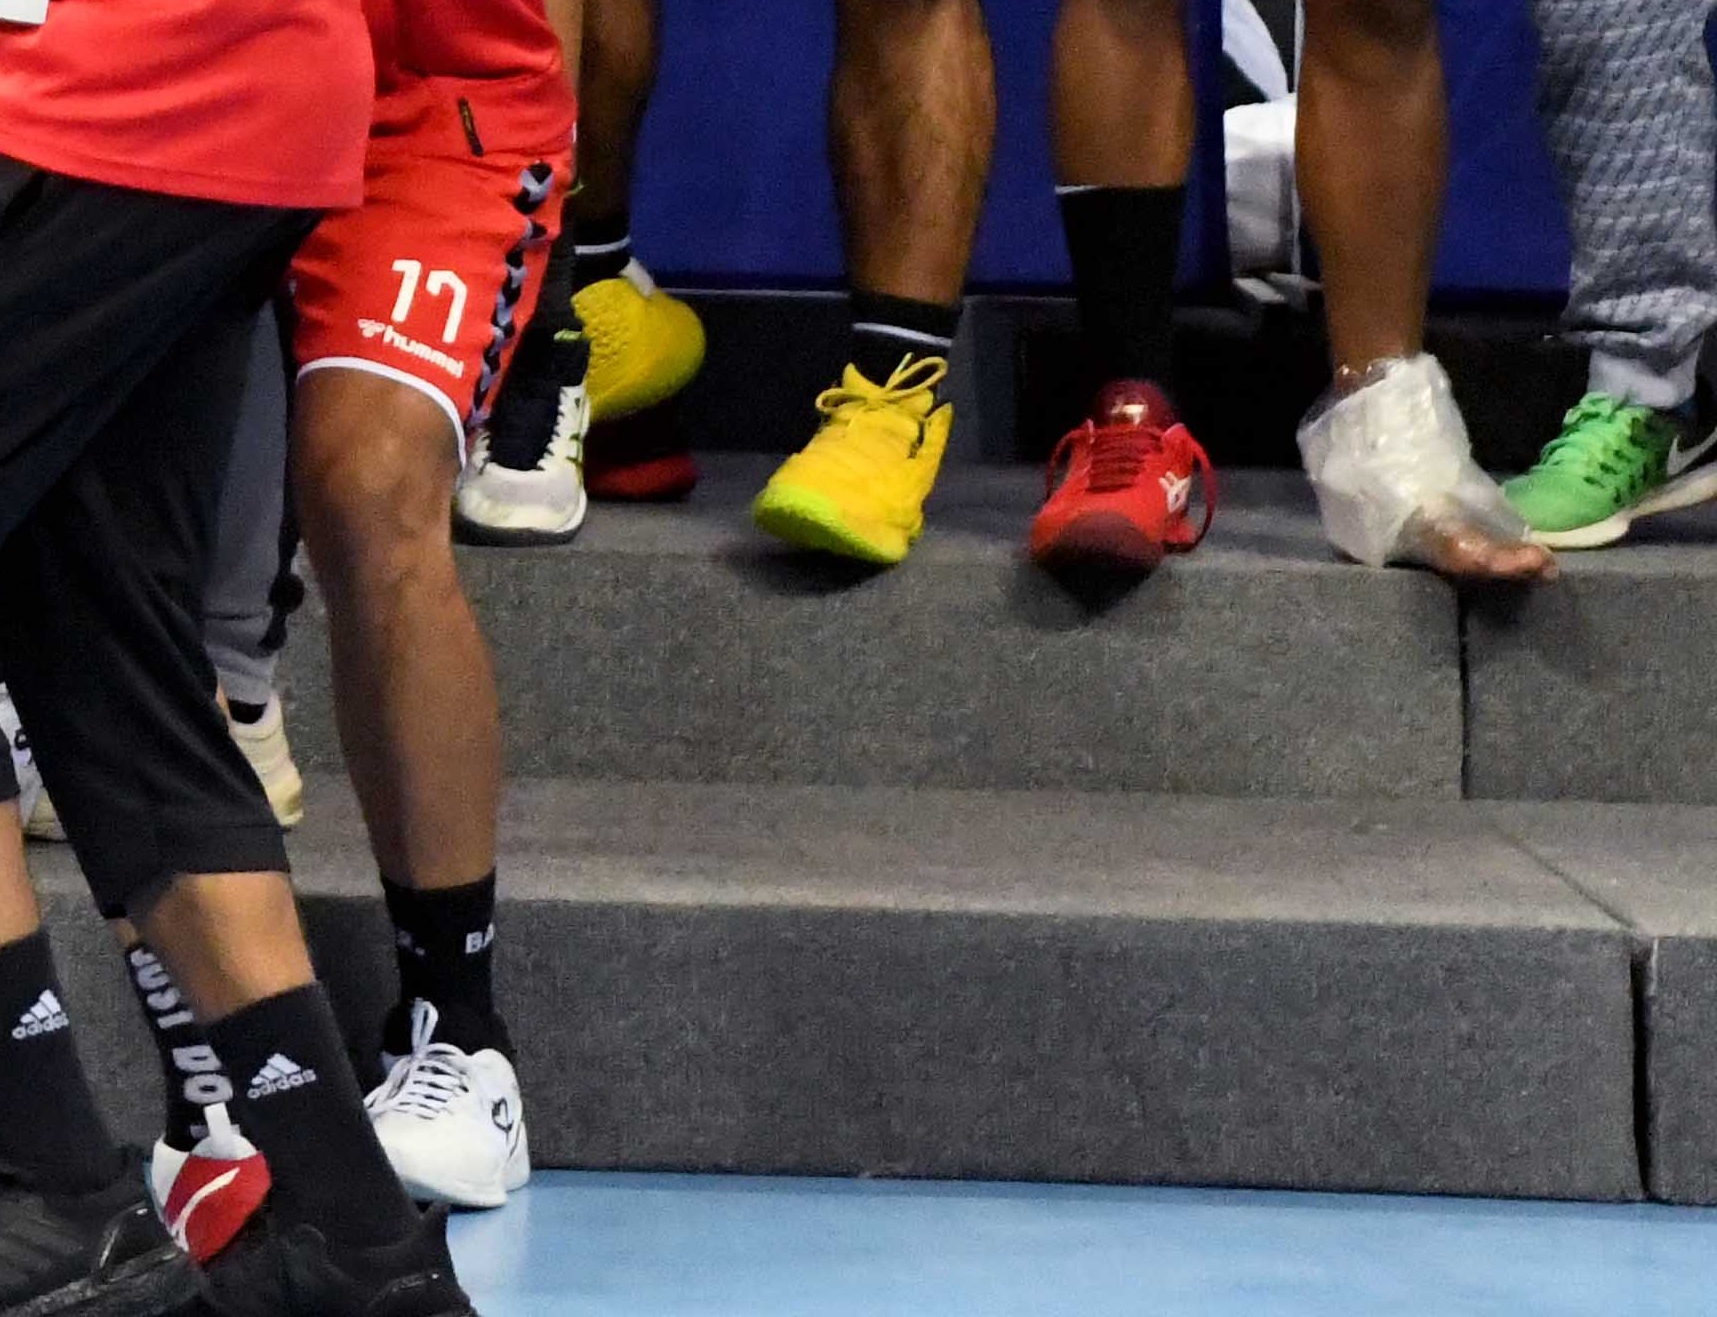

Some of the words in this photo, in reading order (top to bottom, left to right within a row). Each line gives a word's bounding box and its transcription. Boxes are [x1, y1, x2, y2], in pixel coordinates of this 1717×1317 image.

[390, 259, 468, 344] 17
[382, 324, 465, 379] hummel
[11, 1011, 70, 1050] adidas
[172, 1044, 234, 1105] DO
[246, 1067, 317, 1100] adidas
